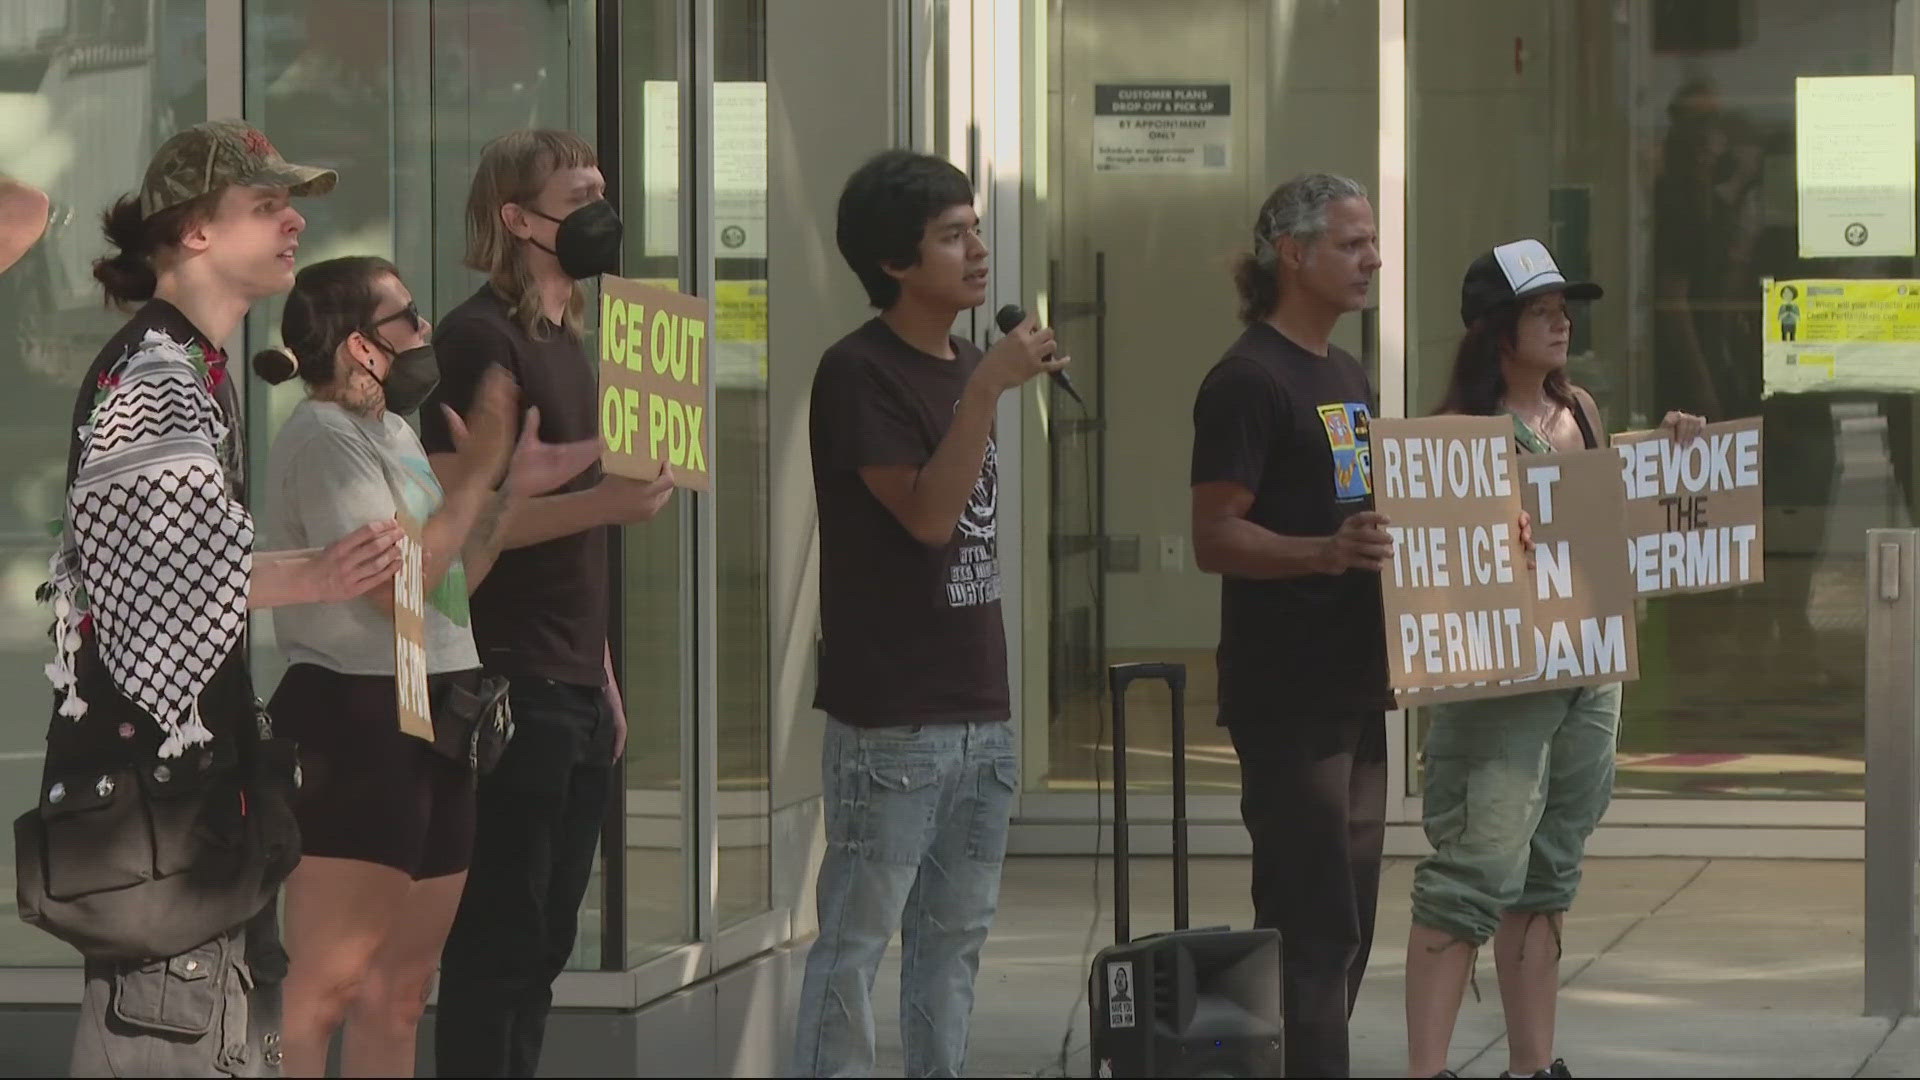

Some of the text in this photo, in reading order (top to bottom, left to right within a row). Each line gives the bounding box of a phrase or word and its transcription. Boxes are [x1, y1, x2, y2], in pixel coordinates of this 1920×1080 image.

[1112, 102, 1162, 112] DROP-OFF
[1118, 89, 1207, 100] CUSTOMER PLANS
[1135, 120, 1206, 129] APPOINTMENT
[1149, 131, 1176, 140] ONLY
[602, 293, 705, 386] ICE OUT
[602, 385, 707, 472] OF PDX
[1382, 436, 1512, 499] REVOKE
[1658, 496, 1709, 532] THE
[1386, 523, 1514, 588] THE ICE
[1399, 608, 1522, 674] PERMIT
